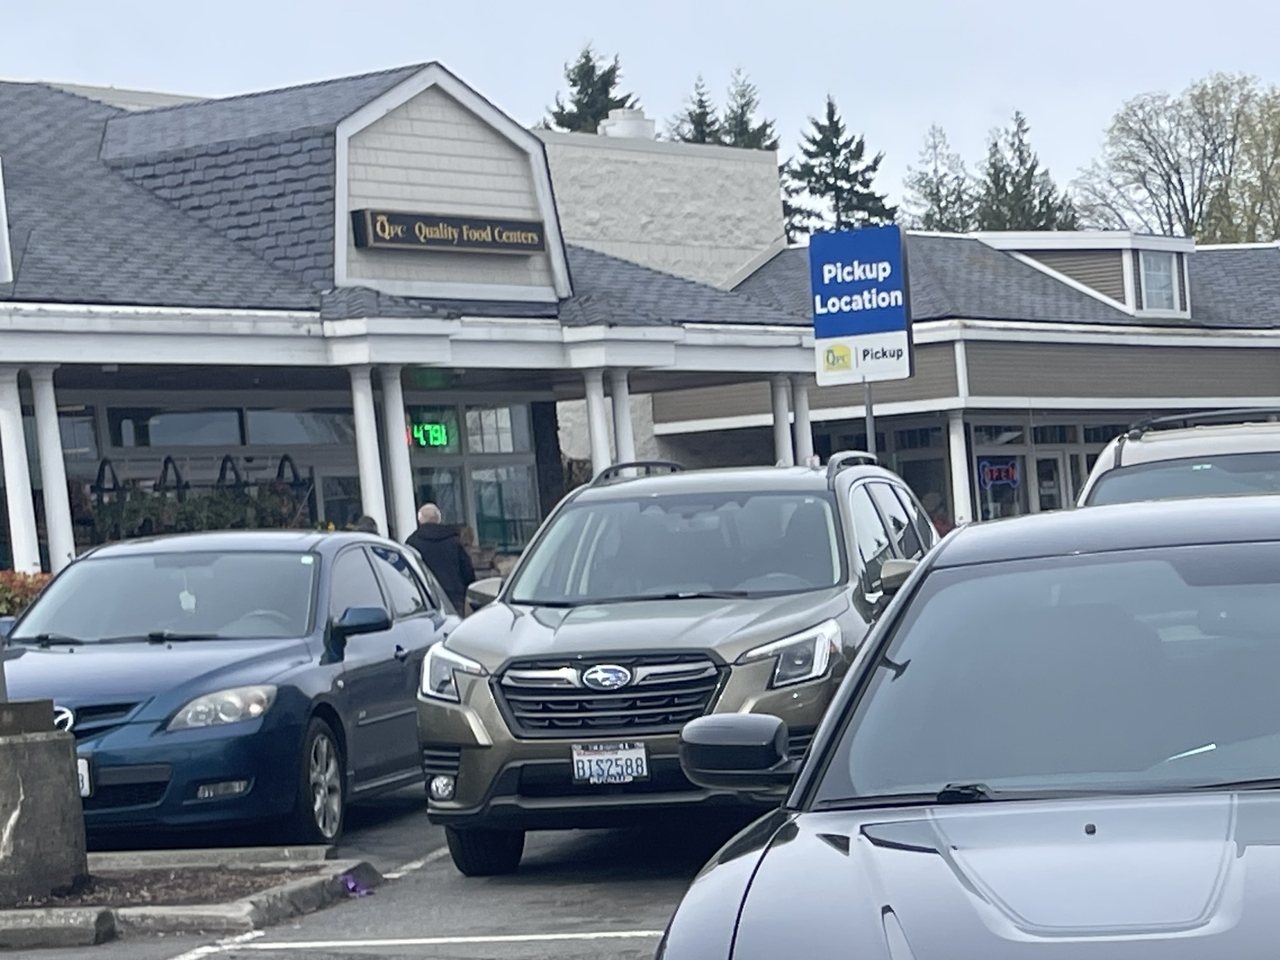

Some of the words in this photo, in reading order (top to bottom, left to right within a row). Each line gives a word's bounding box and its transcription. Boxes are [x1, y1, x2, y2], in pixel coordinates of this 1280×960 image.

[415, 222, 459, 244] Quality
[463, 223, 492, 242] Food
[495, 227, 539, 244] Centers
[823, 260, 891, 284] Pickup
[815, 288, 903, 315] Location
[862, 347, 903, 361] Pickup
[984, 466, 1016, 482] OPEN
[576, 757, 644, 777] BIS2588
